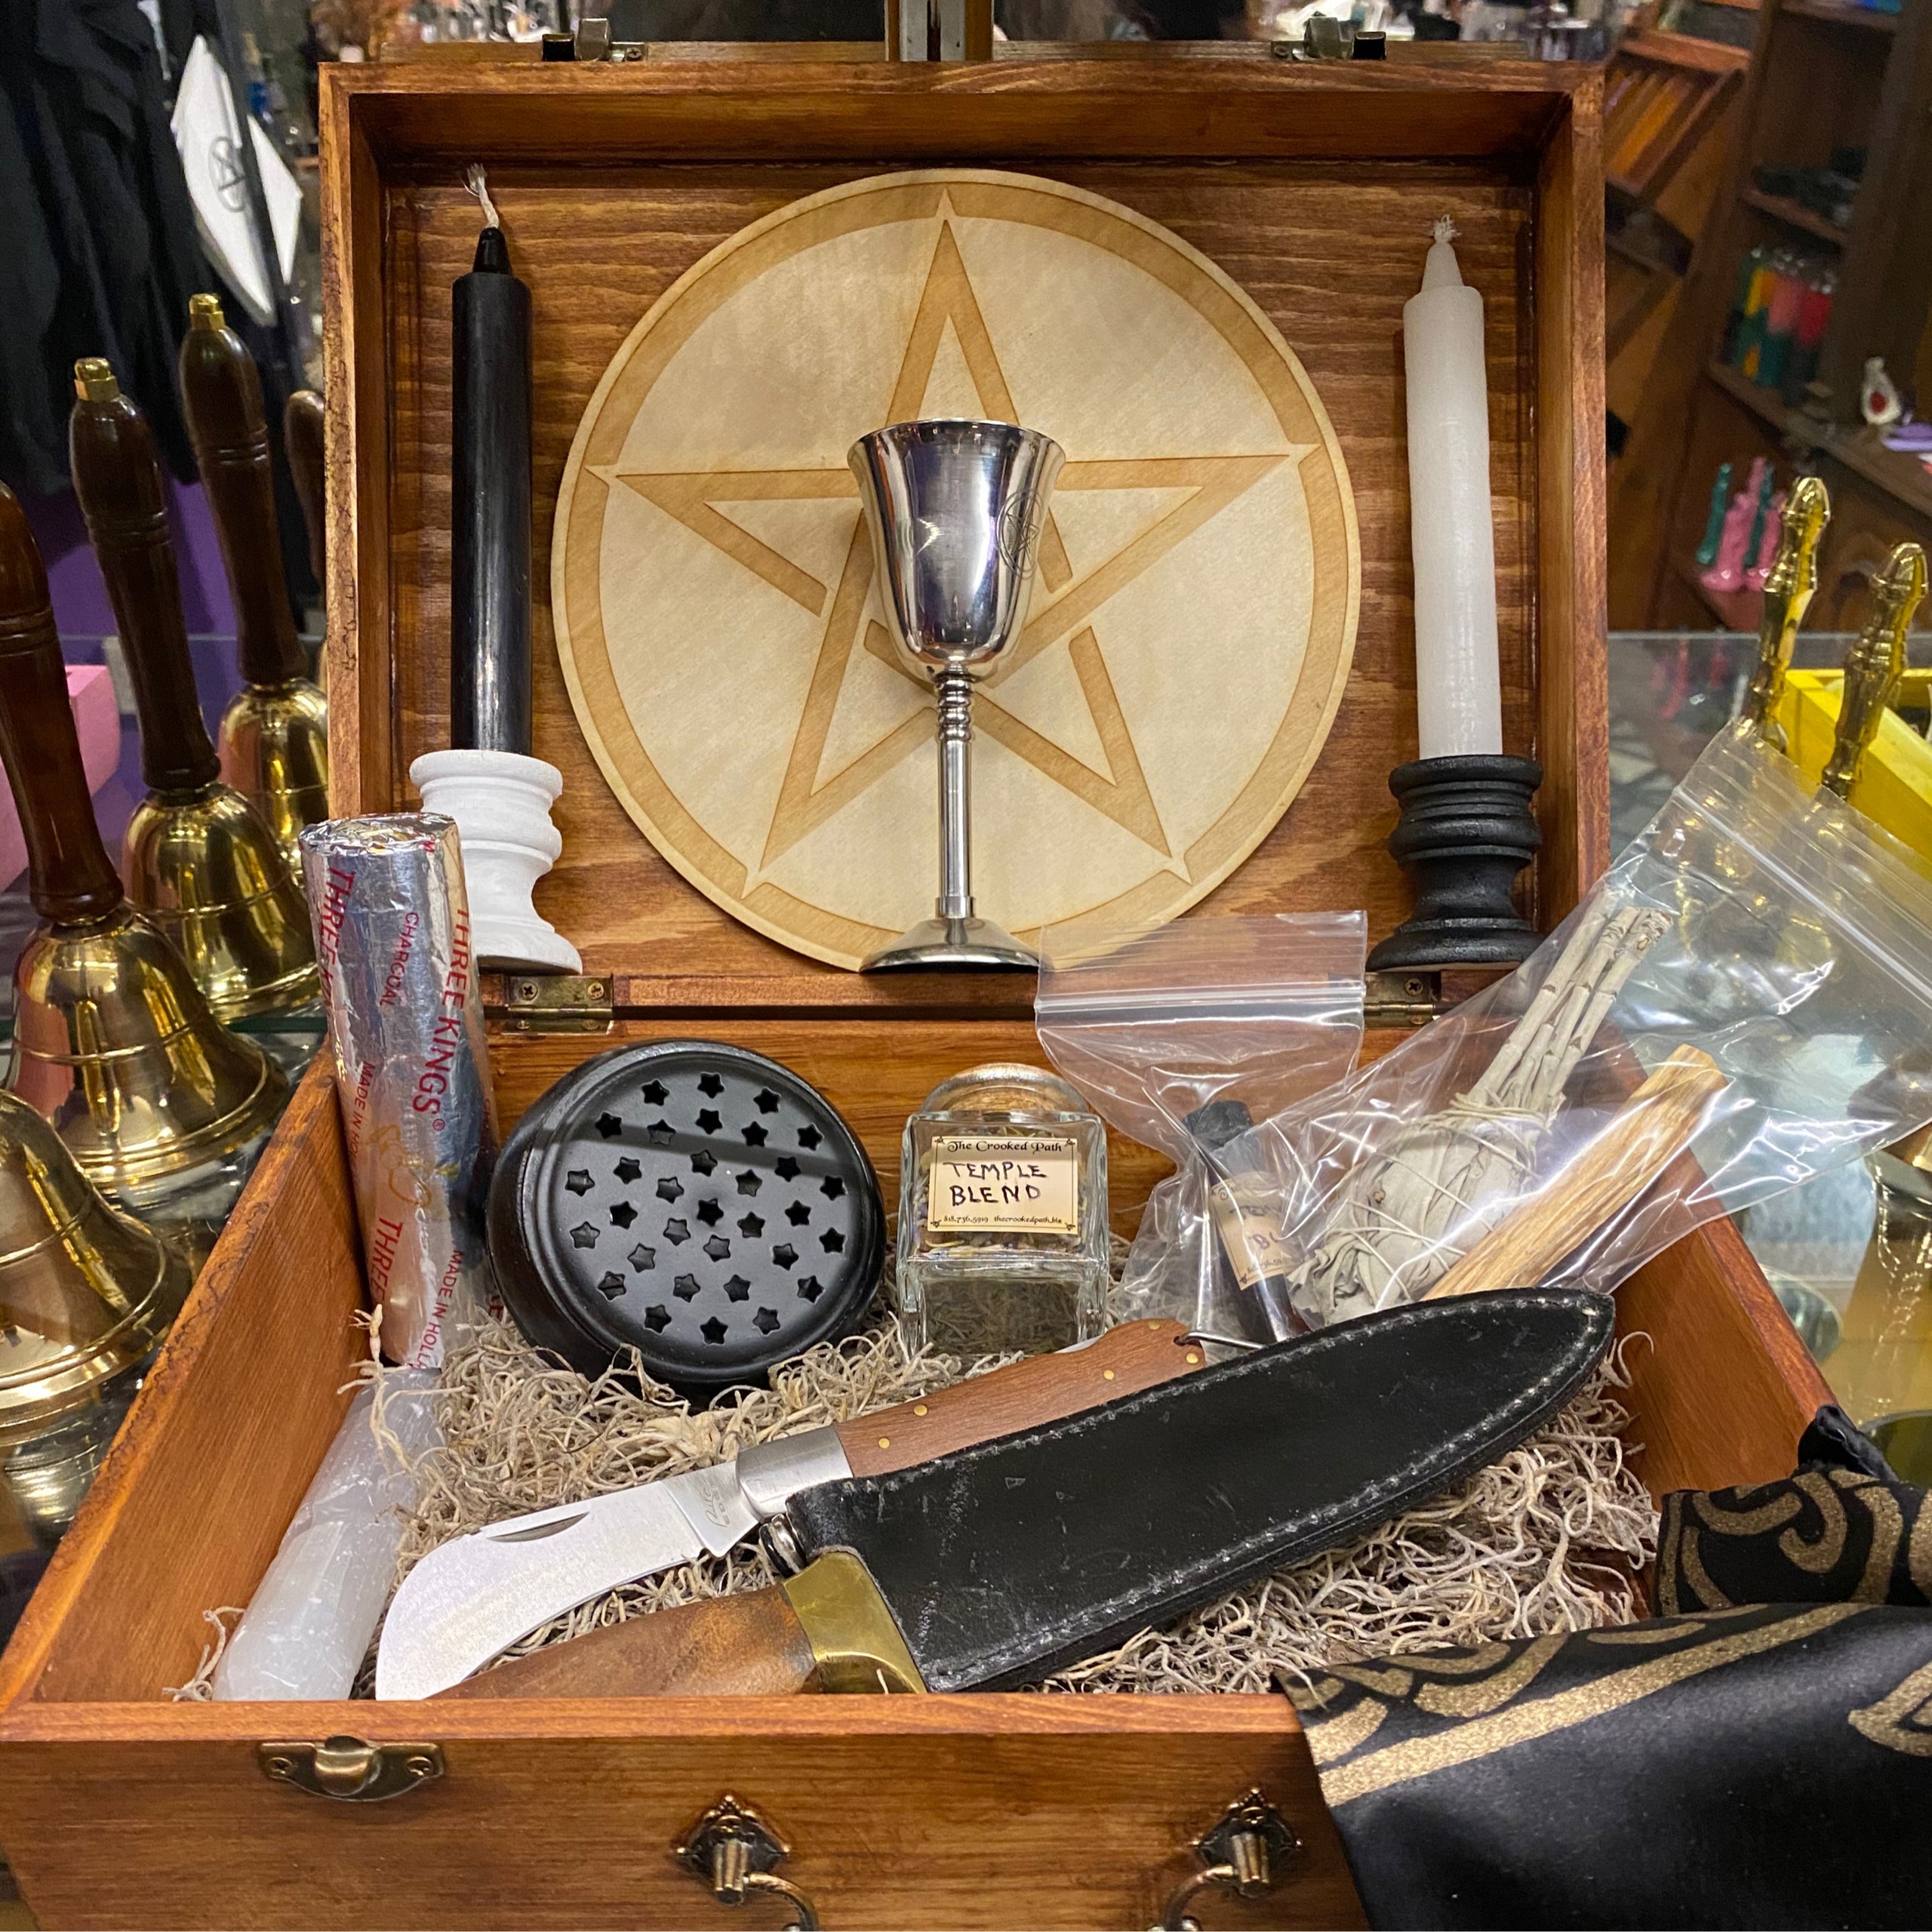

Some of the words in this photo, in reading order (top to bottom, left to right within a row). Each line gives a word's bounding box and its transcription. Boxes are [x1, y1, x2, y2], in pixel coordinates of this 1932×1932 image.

[380, 912, 420, 1007] CHARCOAL
[442, 909, 470, 1010] THREE
[354, 1061, 376, 1111] MADE
[352, 1111, 363, 1130] IN
[947, 1140, 972, 1153] The
[976, 1141, 1028, 1152] Crooked
[1031, 1141, 1063, 1155] Path
[943, 1161, 1048, 1181] TEMPLE
[949, 1185, 1041, 1207] BLEND
[370, 1217, 404, 1303] THREE
[438, 1250, 465, 1299] MADE
[432, 1302, 449, 1319] IN
